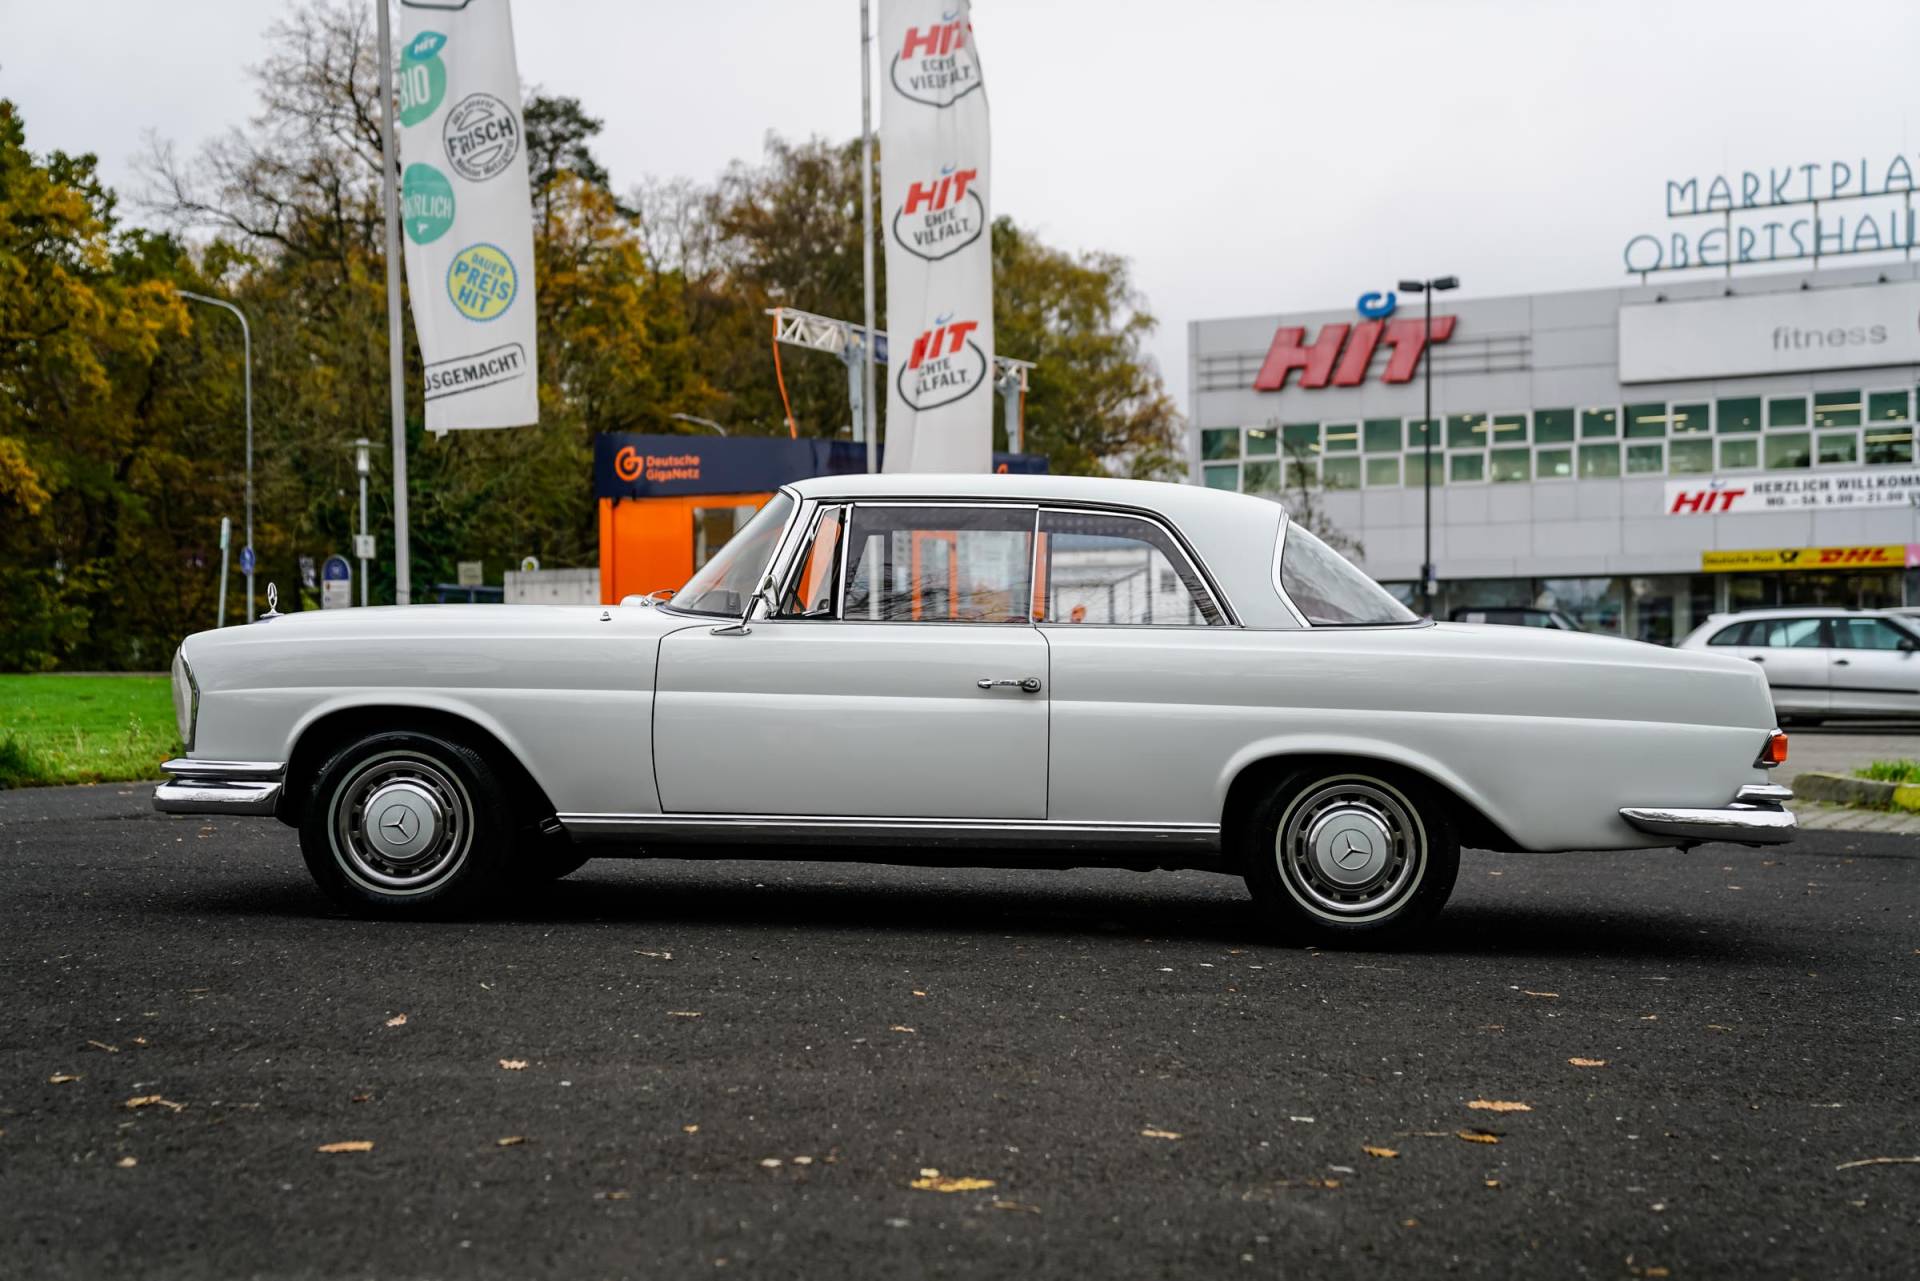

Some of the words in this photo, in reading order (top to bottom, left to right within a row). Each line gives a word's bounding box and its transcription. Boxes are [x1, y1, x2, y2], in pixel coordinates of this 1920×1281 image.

[447, 116, 514, 157] FRISCH
[903, 169, 977, 215] HIT
[1667, 153, 1920, 217] MARKTPLA
[471, 253, 507, 276] DAUER
[454, 261, 511, 301] PREIS
[458, 285, 494, 313] HIT
[1772, 325, 1888, 350] fitness
[1253, 316, 1457, 393] HIT
[646, 455, 700, 467] Deutsche
[646, 468, 700, 482] GigaNetz
[1753, 479, 1830, 495] HERZLICH
[1670, 489, 1746, 514] HIT
[1819, 548, 1889, 563] DHL
